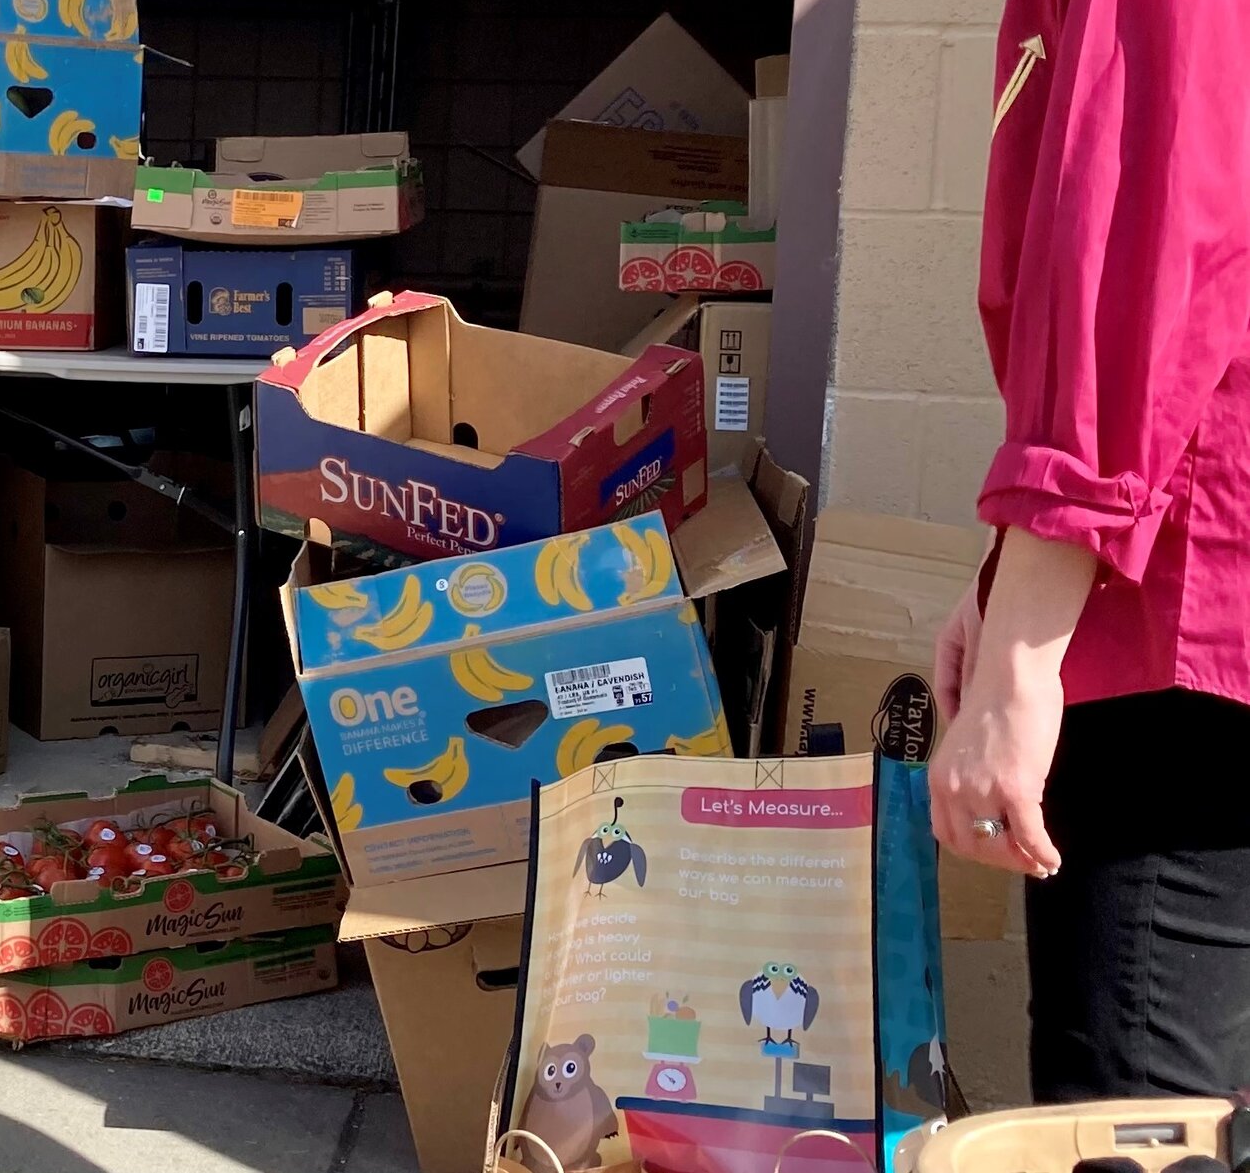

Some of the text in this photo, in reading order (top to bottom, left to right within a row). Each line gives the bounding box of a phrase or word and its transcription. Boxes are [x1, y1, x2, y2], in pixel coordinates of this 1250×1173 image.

[233, 289, 271, 303] Farmer's
[233, 302, 252, 314] Best
[25, 320, 74, 332] BANANAS
[210, 333, 245, 342] RIPENED
[247, 334, 290, 342] TOMATOES
[406, 525, 449, 549] Perfect
[97, 663, 190, 698] organicgirl
[597, 672, 646, 686] CAVENDISH
[329, 686, 420, 727] One
[641, 693, 654, 704] 57
[340, 717, 426, 741] BANANA MAKES A
[888, 703, 904, 747] FARMS
[342, 729, 430, 756] DIFFERENCE
[700, 797, 844, 817] Let's Measure...
[679, 847, 847, 870] Describe the different
[678, 868, 845, 889] ways we can measure
[678, 886, 740, 906] our bag
[145, 902, 245, 937] MagicSun
[590, 912, 638, 926] decide
[584, 932, 641, 946] is heavy
[575, 949, 653, 965] What could
[587, 972, 603, 983] or
[604, 968, 654, 984] lighter
[128, 978, 228, 1015] MagicSun
[575, 987, 607, 1004] bag?
